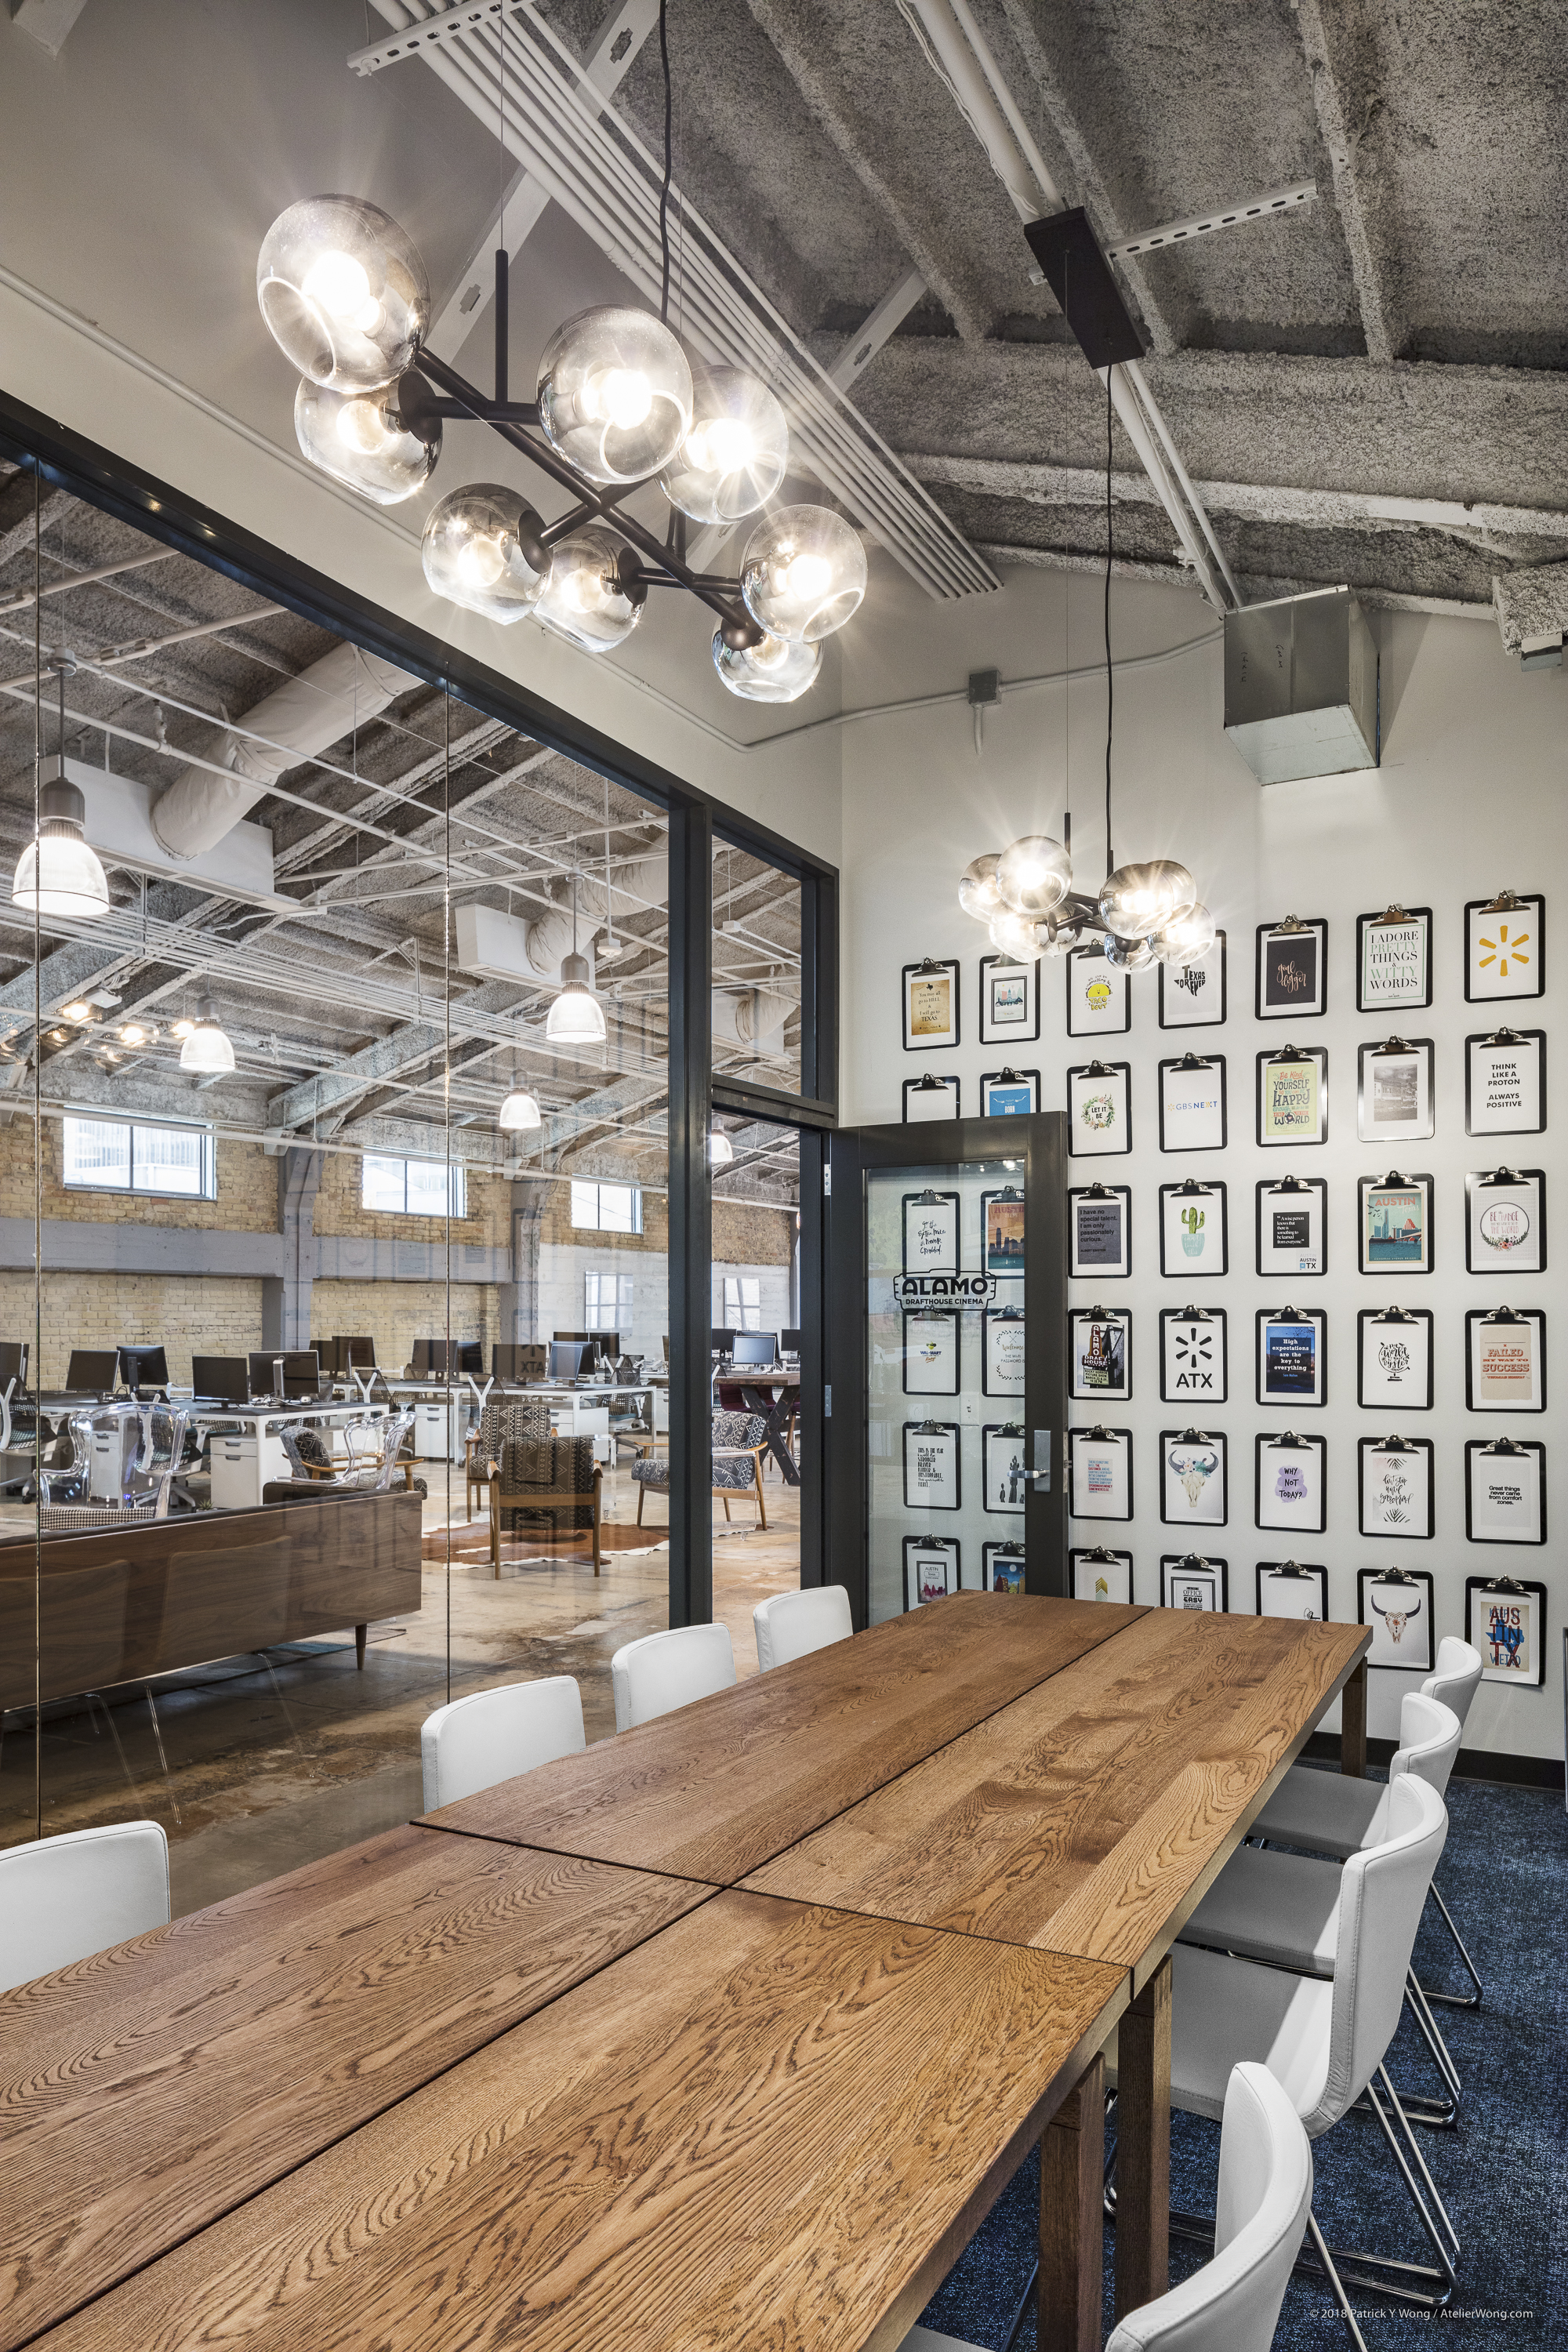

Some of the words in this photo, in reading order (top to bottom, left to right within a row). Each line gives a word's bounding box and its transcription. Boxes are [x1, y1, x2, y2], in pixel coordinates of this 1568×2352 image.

[1371, 935, 1374, 943] I
[1377, 931, 1418, 943] ADORE
[1370, 941, 1417, 953] PRETTY
[1370, 950, 1417, 964] THINGS
[1182, 964, 1206, 981] TEXAS
[1276, 960, 1297, 983] goal
[1370, 965, 1417, 979] WITTY
[1174, 979, 1206, 996] FOREVER
[1281, 970, 1307, 993] digger
[1370, 977, 1417, 989] WORDS
[1279, 1071, 1288, 1080] Be
[1290, 1069, 1304, 1080] Kind
[1273, 1079, 1310, 1091] YOURSELF
[1272, 1088, 1311, 1107] HAPPY
[1274, 1112, 1310, 1125] WORLD
[1375, 1197, 1416, 1207] AUSTIN
[1397, 1204, 1419, 1214] Texas
[1490, 1211, 1497, 1221] BE
[1501, 1225, 1519, 1234] WORLD
[902, 1278, 988, 1295] ALAMO
[1002, 1343, 1025, 1352] Welcome
[1381, 1346, 1409, 1358] world
[1487, 1348, 1524, 1357] FAILED
[1483, 1363, 1530, 1372] SUCCESS
[1176, 1373, 1213, 1388] ATX
[1279, 1490, 1303, 1500] TODAY?
[1490, 1606, 1521, 1625] AUS
[1489, 1624, 1521, 1644] TIN
[1489, 1642, 1521, 1668] TX
